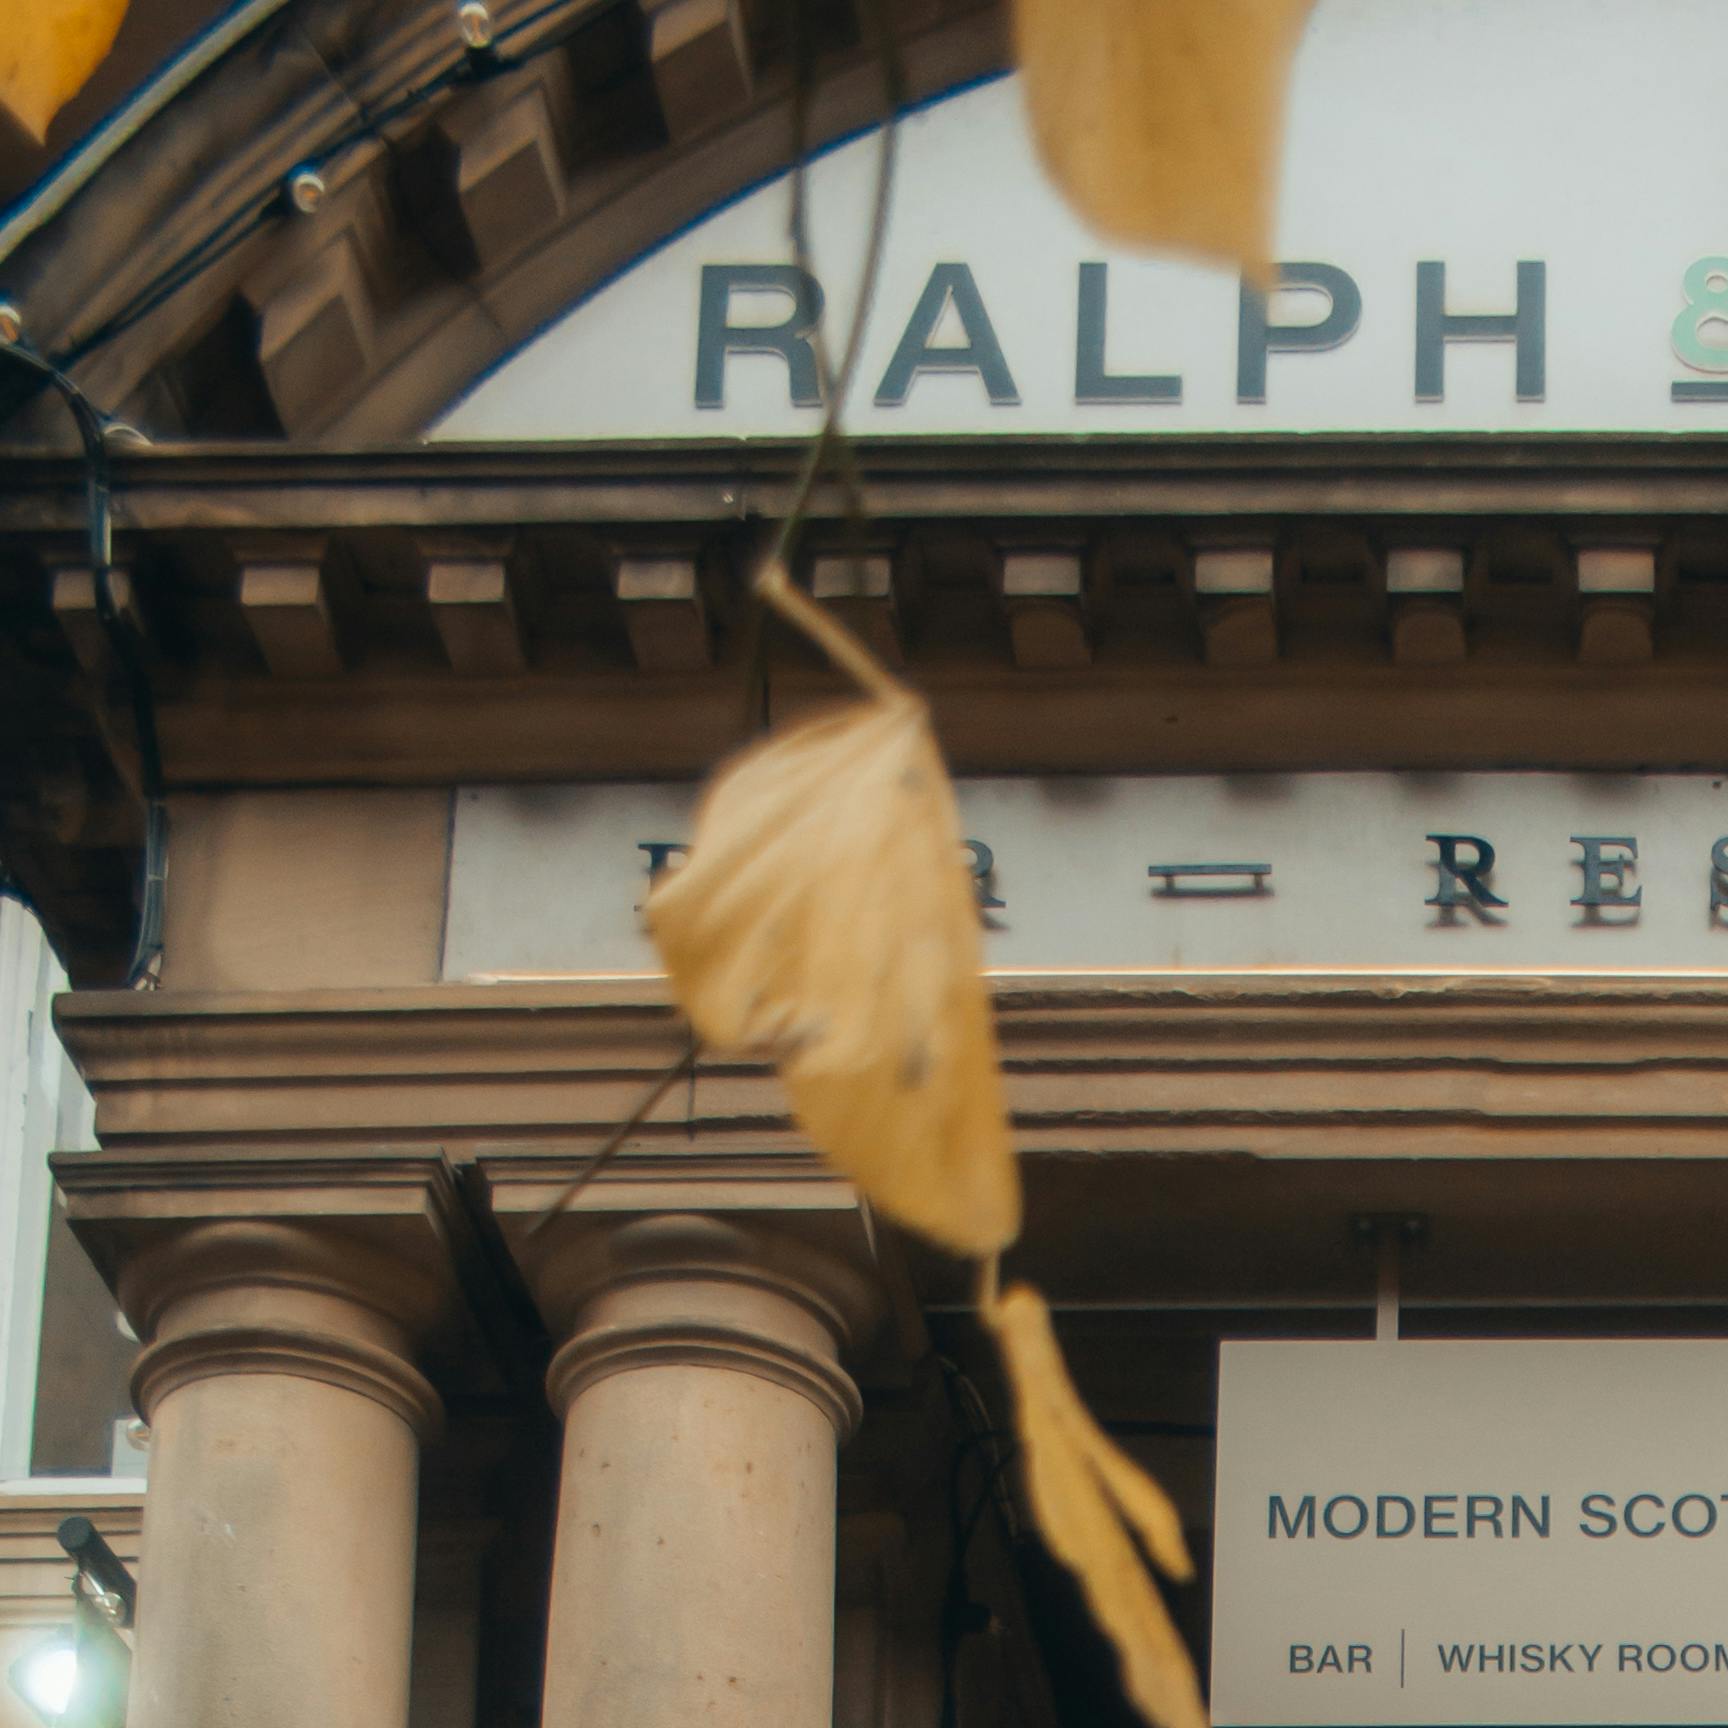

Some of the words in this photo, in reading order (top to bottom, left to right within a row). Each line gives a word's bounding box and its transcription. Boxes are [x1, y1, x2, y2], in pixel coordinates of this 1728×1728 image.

[695, 262, 1546, 409] RALPH
[1267, 1493, 1552, 1541] MODERN
[1288, 1643, 1375, 1676] BAR
[1437, 1643, 1605, 1676] WHISKY
